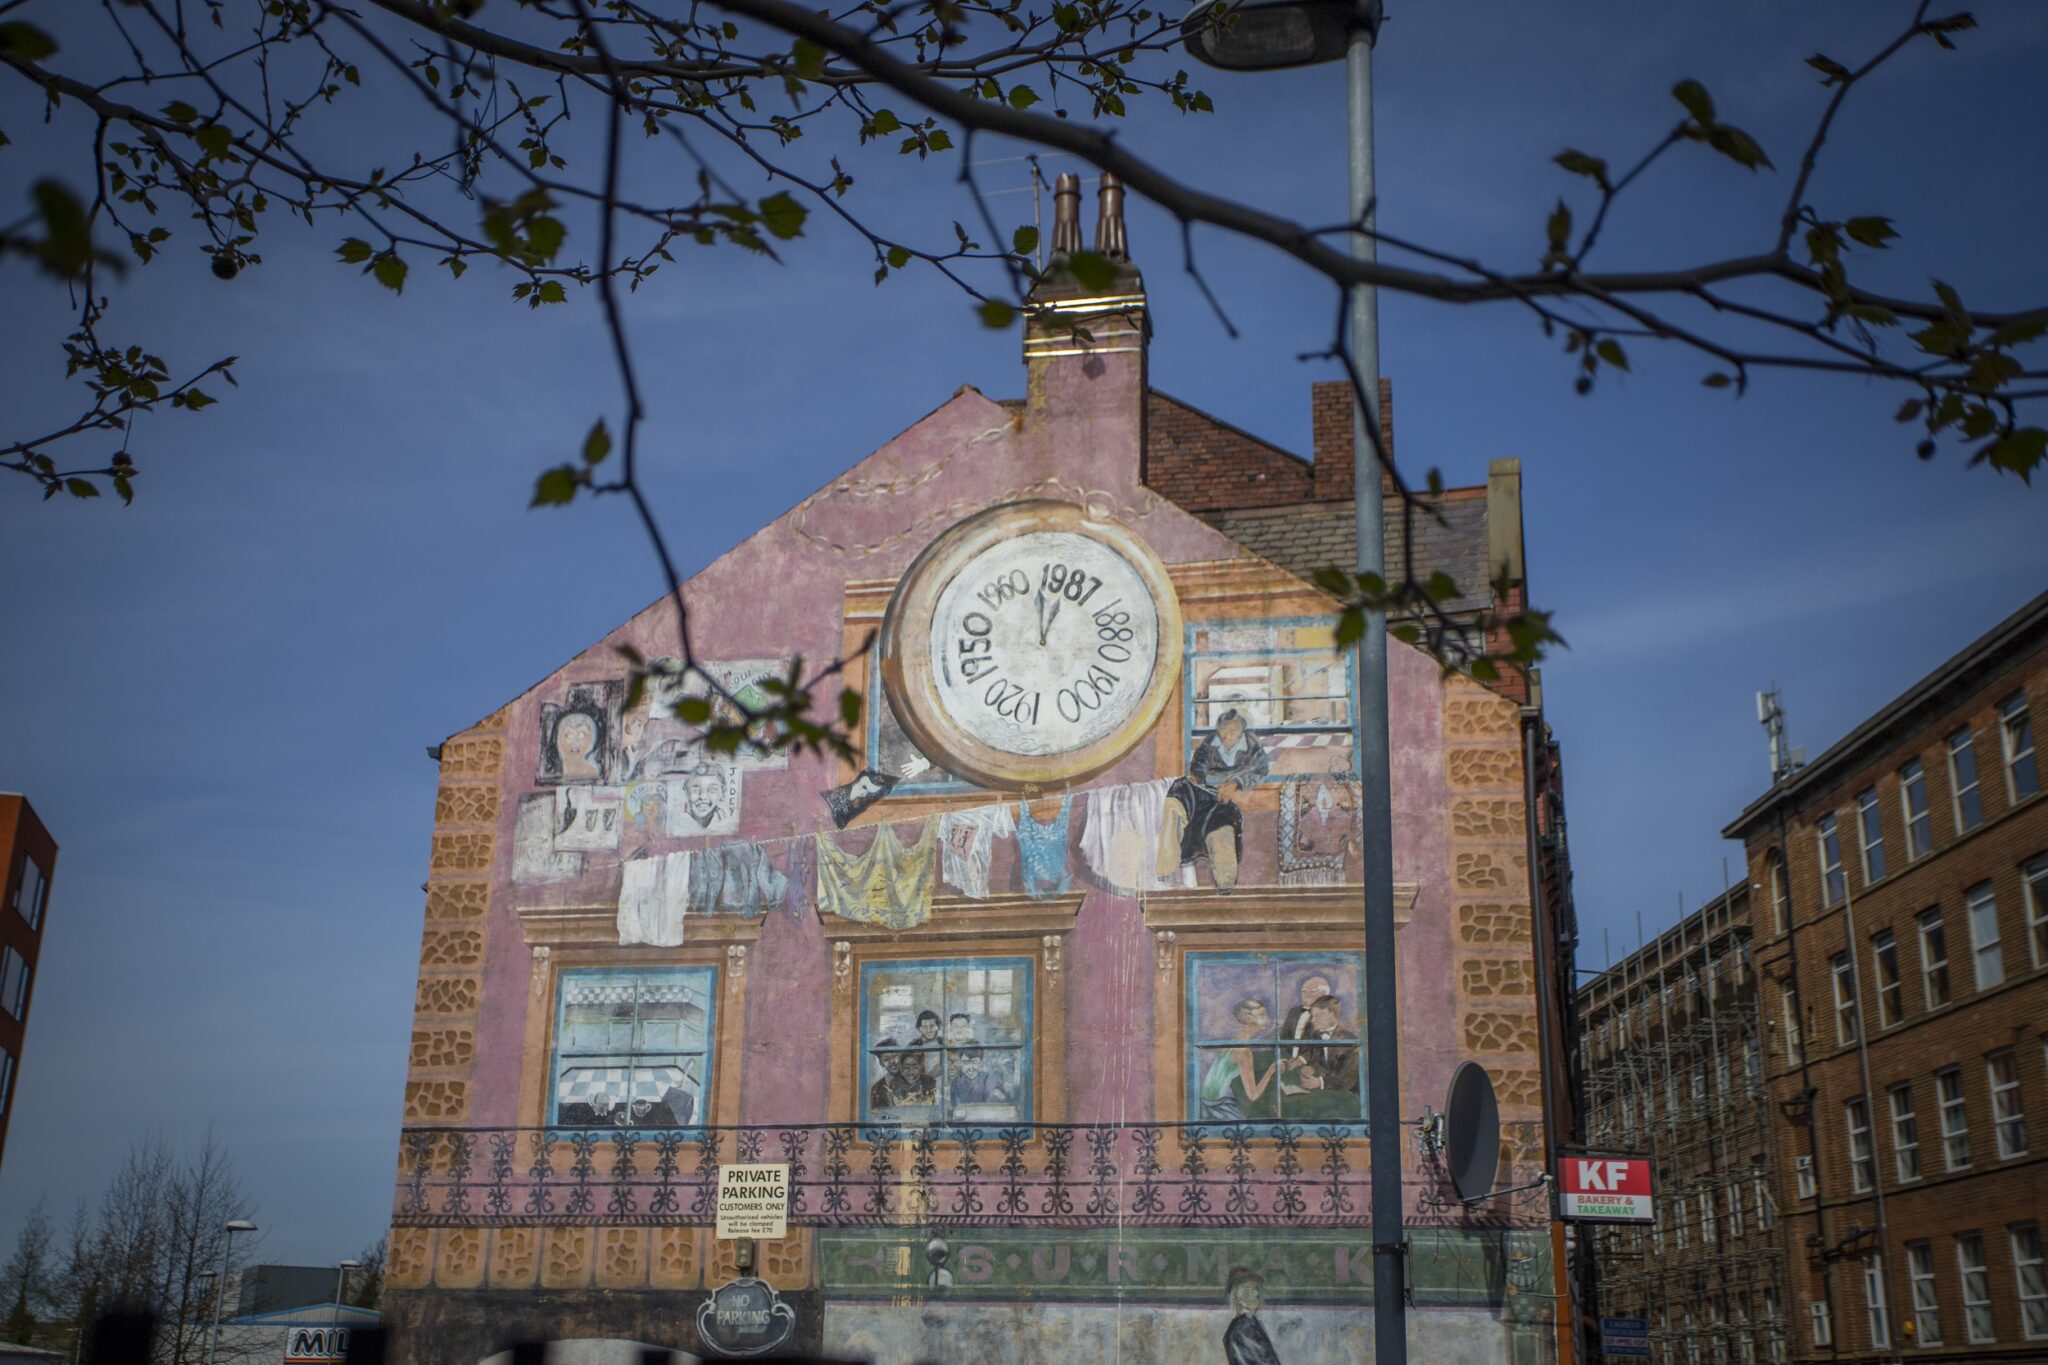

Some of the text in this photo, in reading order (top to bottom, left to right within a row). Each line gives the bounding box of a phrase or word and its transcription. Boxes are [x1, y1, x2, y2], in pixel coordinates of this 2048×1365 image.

[976, 570, 1030, 611] 1960
[1041, 563, 1103, 606] 1987
[1091, 598, 1133, 663] 1880
[959, 612, 999, 684] 1950
[984, 679, 1041, 725] 1920
[1057, 665, 1121, 723] 1900
[728, 1170, 781, 1183] PRIVATE
[1578, 1160, 1629, 1191] KF
[722, 1186, 785, 1199] PARKING
[1577, 1195, 1634, 1206] BAKERY &
[719, 1202, 785, 1211] CUSTOMERS ONLY
[1576, 1205, 1636, 1215] TAKEAWAY
[732, 1294, 750, 1307] NO
[717, 1309, 771, 1325] PARKING
